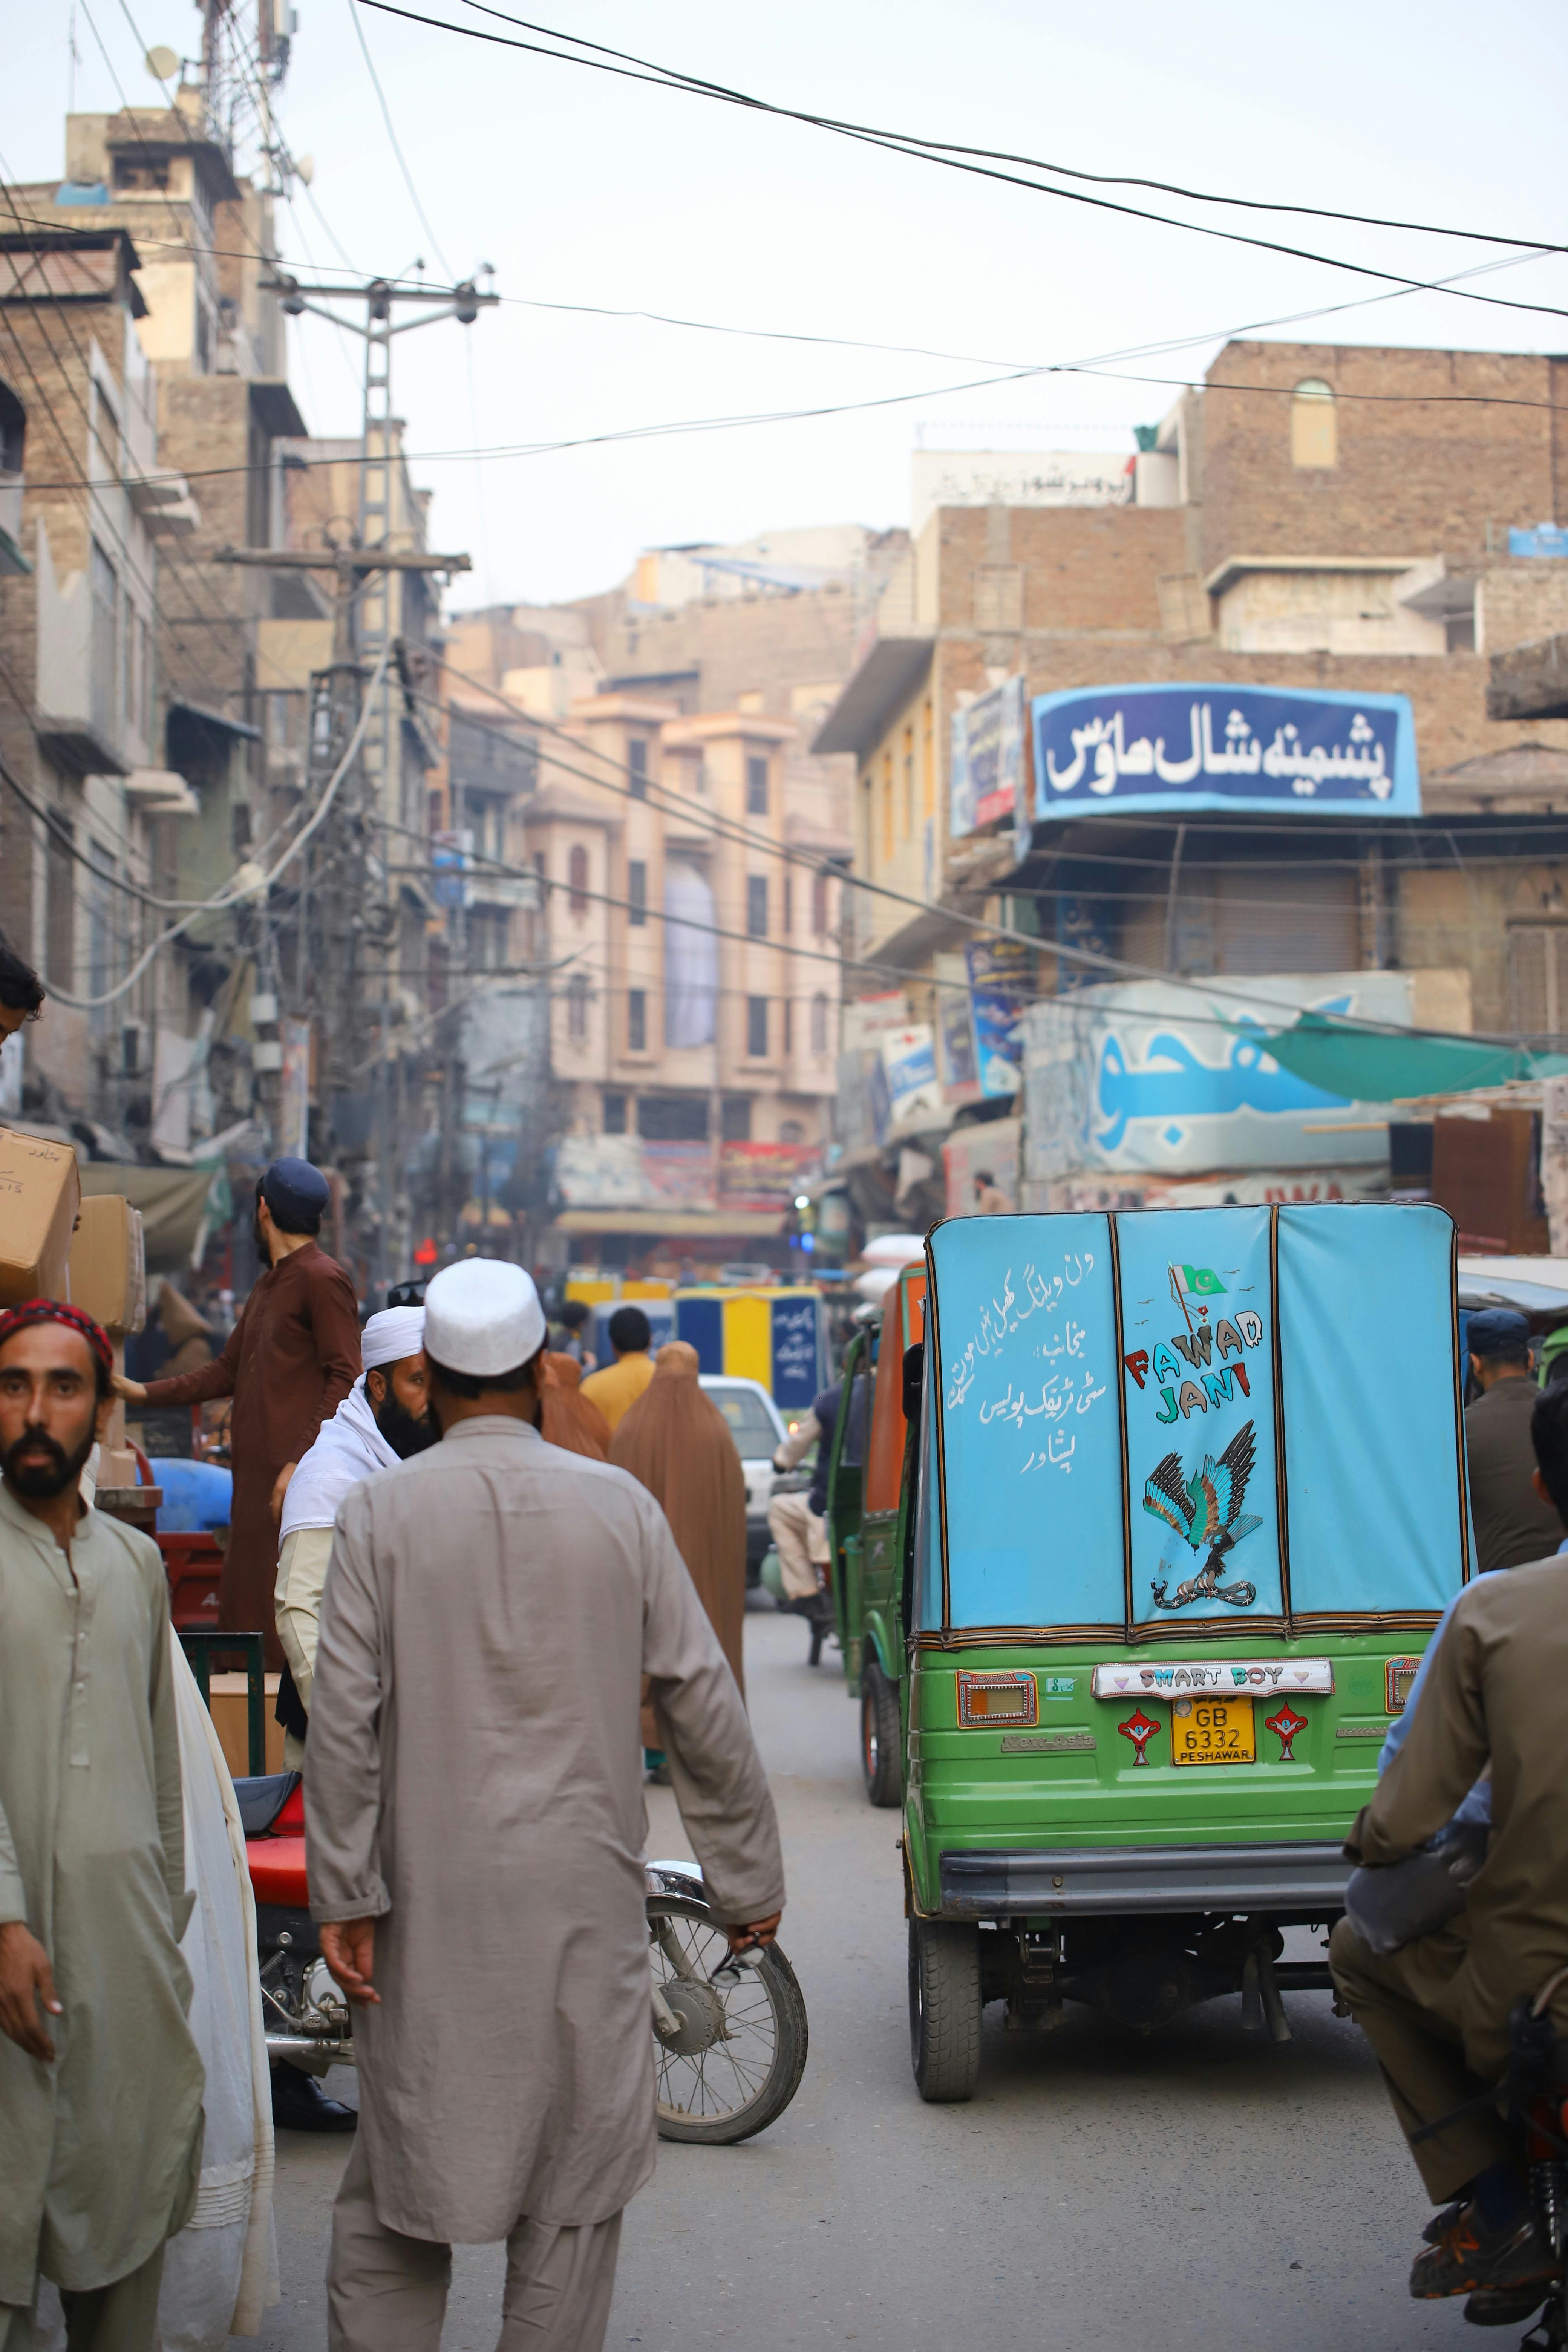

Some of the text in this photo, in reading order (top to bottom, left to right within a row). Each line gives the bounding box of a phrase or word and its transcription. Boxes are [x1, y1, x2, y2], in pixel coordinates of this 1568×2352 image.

[1156, 704, 1262, 783] شال
[1262, 714, 1392, 804] پشمینہ
[1064, 1253, 1094, 1286] ون
[1124, 1311, 1262, 1389] FAWAD
[979, 1383, 1024, 1429] پولیس
[1024, 1375, 1074, 1422] ٹریفک
[1156, 1362, 1250, 1424] JANI
[1020, 1429, 1075, 1474] پشاور
[1139, 1666, 1284, 1688] SMART BOY
[1185, 1728, 1240, 1749] 6332
[1196, 1708, 1228, 1727] GB
[1180, 1750, 1249, 1762] PESHAWAR
